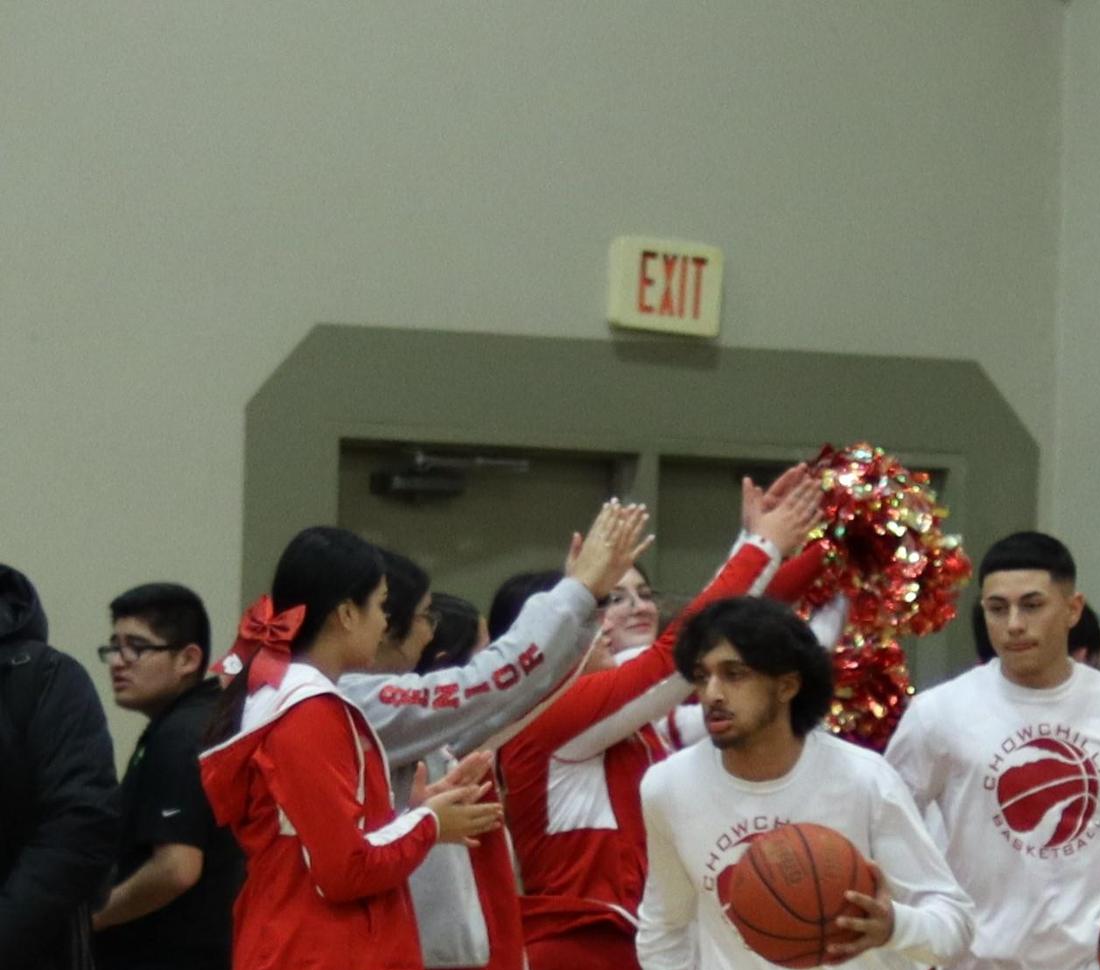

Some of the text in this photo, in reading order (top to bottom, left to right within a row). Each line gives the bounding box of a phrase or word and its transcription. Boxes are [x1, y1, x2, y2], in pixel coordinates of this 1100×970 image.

[637, 250, 708, 319] EXIT
[379, 643, 544, 708] SENIOR
[703, 815, 790, 892] CHOWCH
